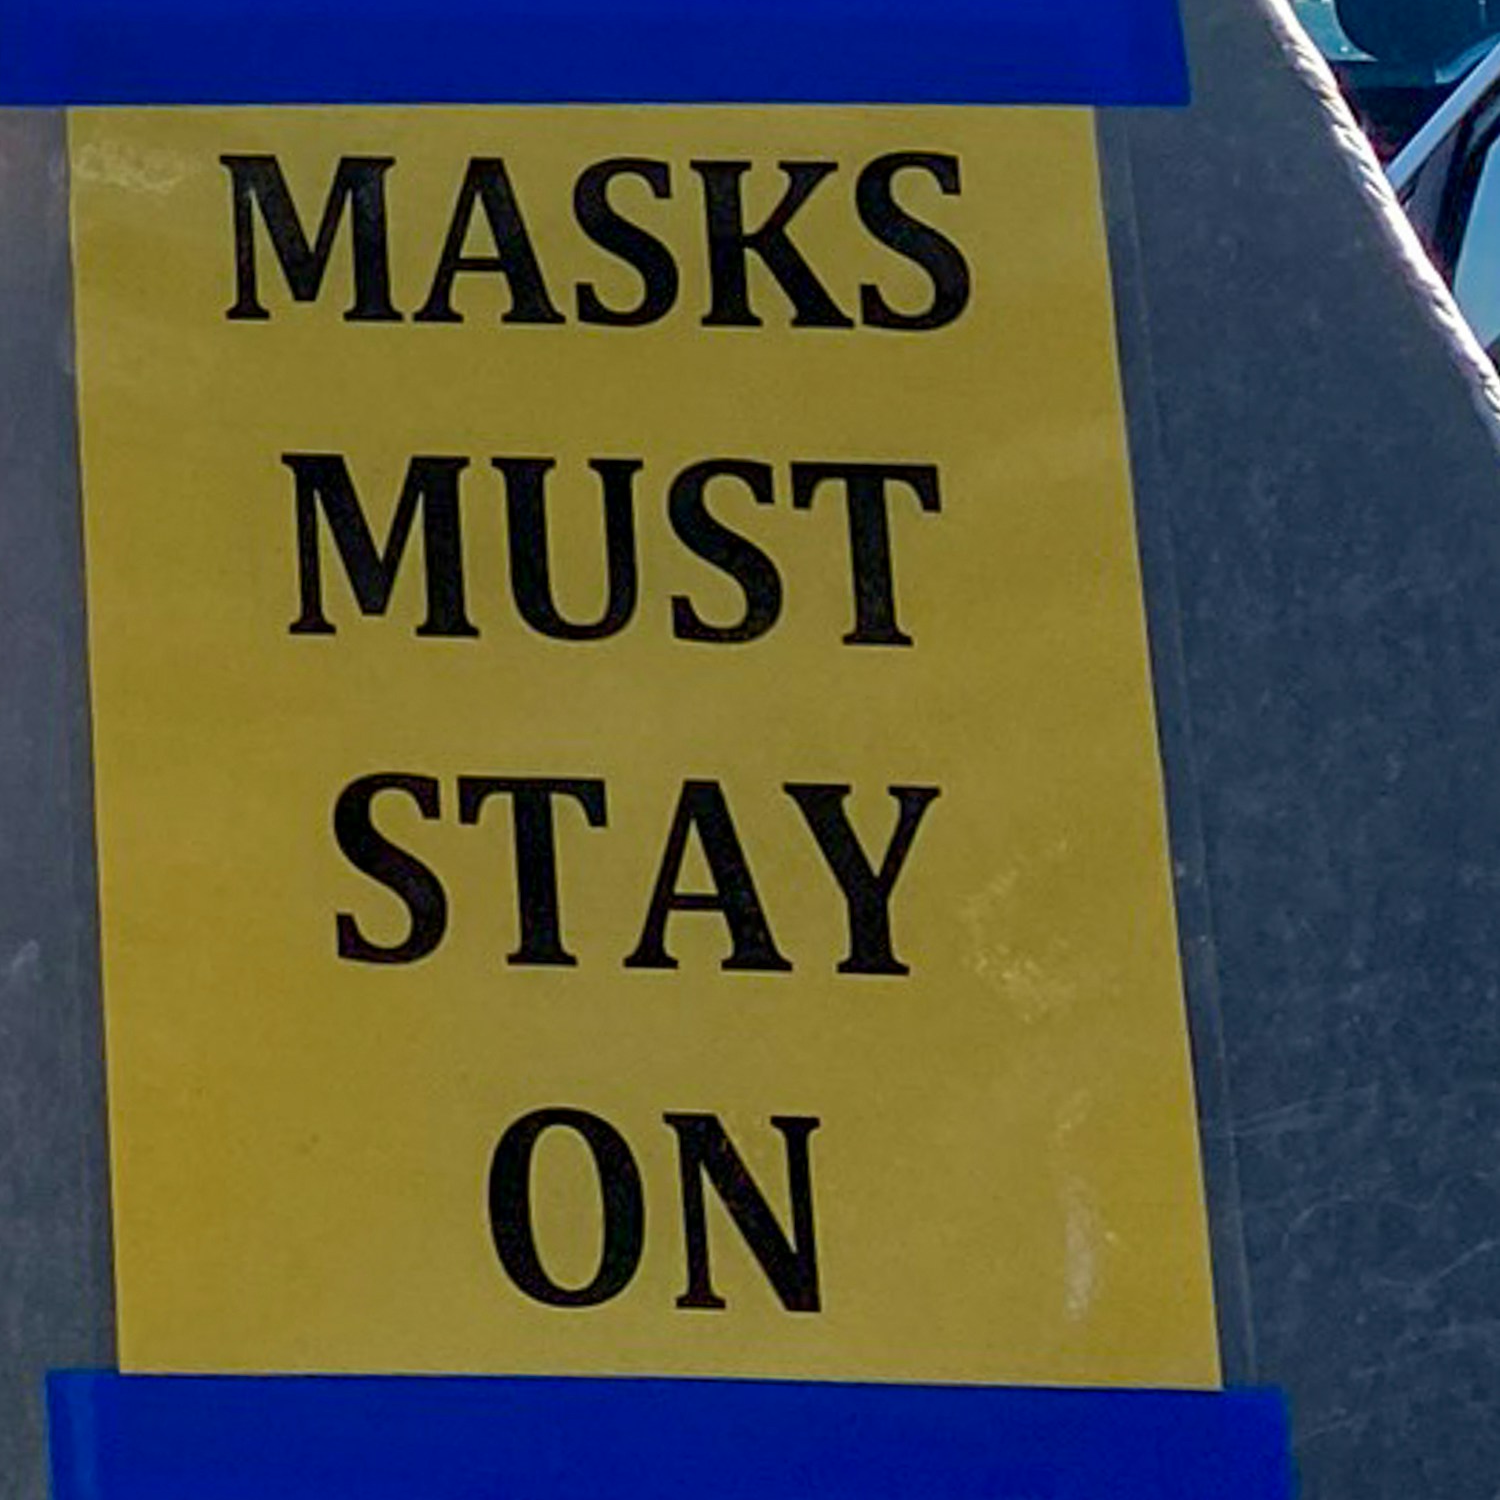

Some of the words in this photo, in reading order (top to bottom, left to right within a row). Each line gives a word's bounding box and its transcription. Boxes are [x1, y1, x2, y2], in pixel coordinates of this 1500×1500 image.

[218, 150, 972, 333] MASKS
[280, 452, 943, 648] MUST
[332, 771, 943, 977] STAY
[487, 1106, 823, 1314] ON
